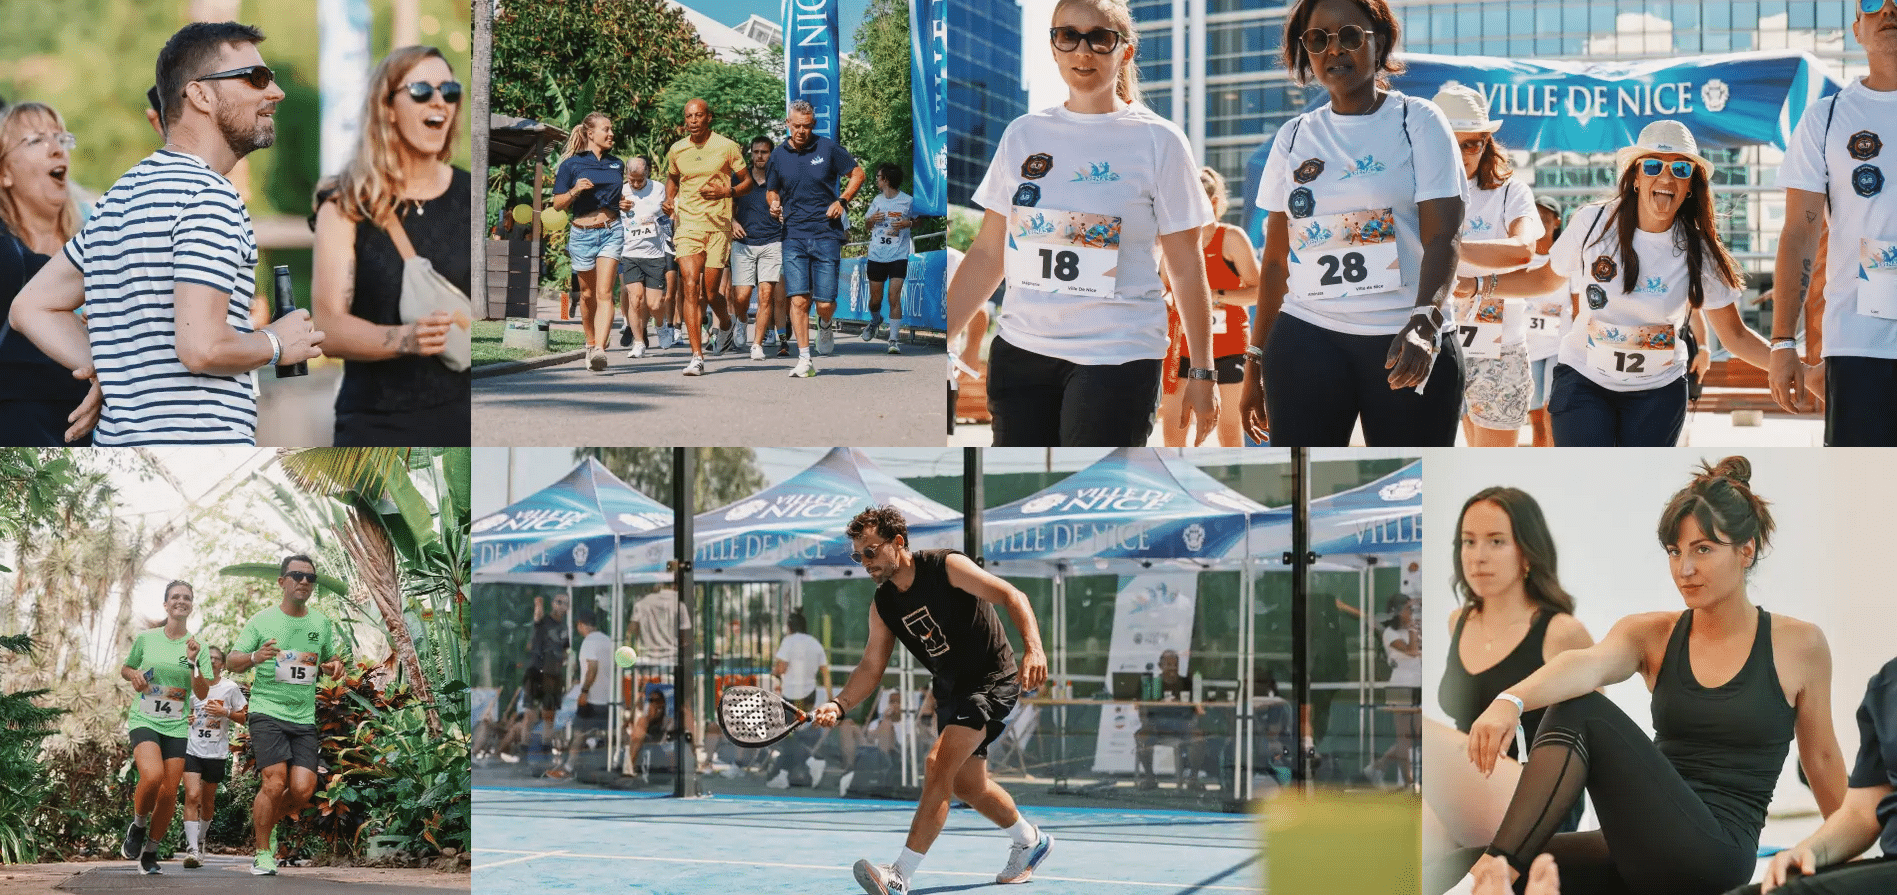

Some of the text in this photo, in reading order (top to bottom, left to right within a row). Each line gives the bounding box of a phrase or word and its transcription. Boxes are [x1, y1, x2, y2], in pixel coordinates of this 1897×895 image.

[798, 56, 830, 96] DE
[1476, 82, 1694, 117] VILLE DE NICE
[880, 236, 892, 245] 36
[1038, 248, 1080, 282] 18
[1316, 251, 1368, 286] 28
[1529, 317, 1545, 330] 31
[1459, 325, 1478, 348] 7
[1613, 351, 1646, 373] 12
[1077, 487, 1139, 498] VILLE
[757, 503, 847, 519] NICE
[1060, 496, 1166, 511] NICE
[495, 518, 573, 531] NICE
[986, 523, 1046, 552] VILLE
[1053, 523, 1084, 550] DE
[746, 534, 772, 560] DE
[290, 666, 306, 680] 15
[154, 700, 172, 714] 14
[198, 729, 212, 738] 36
